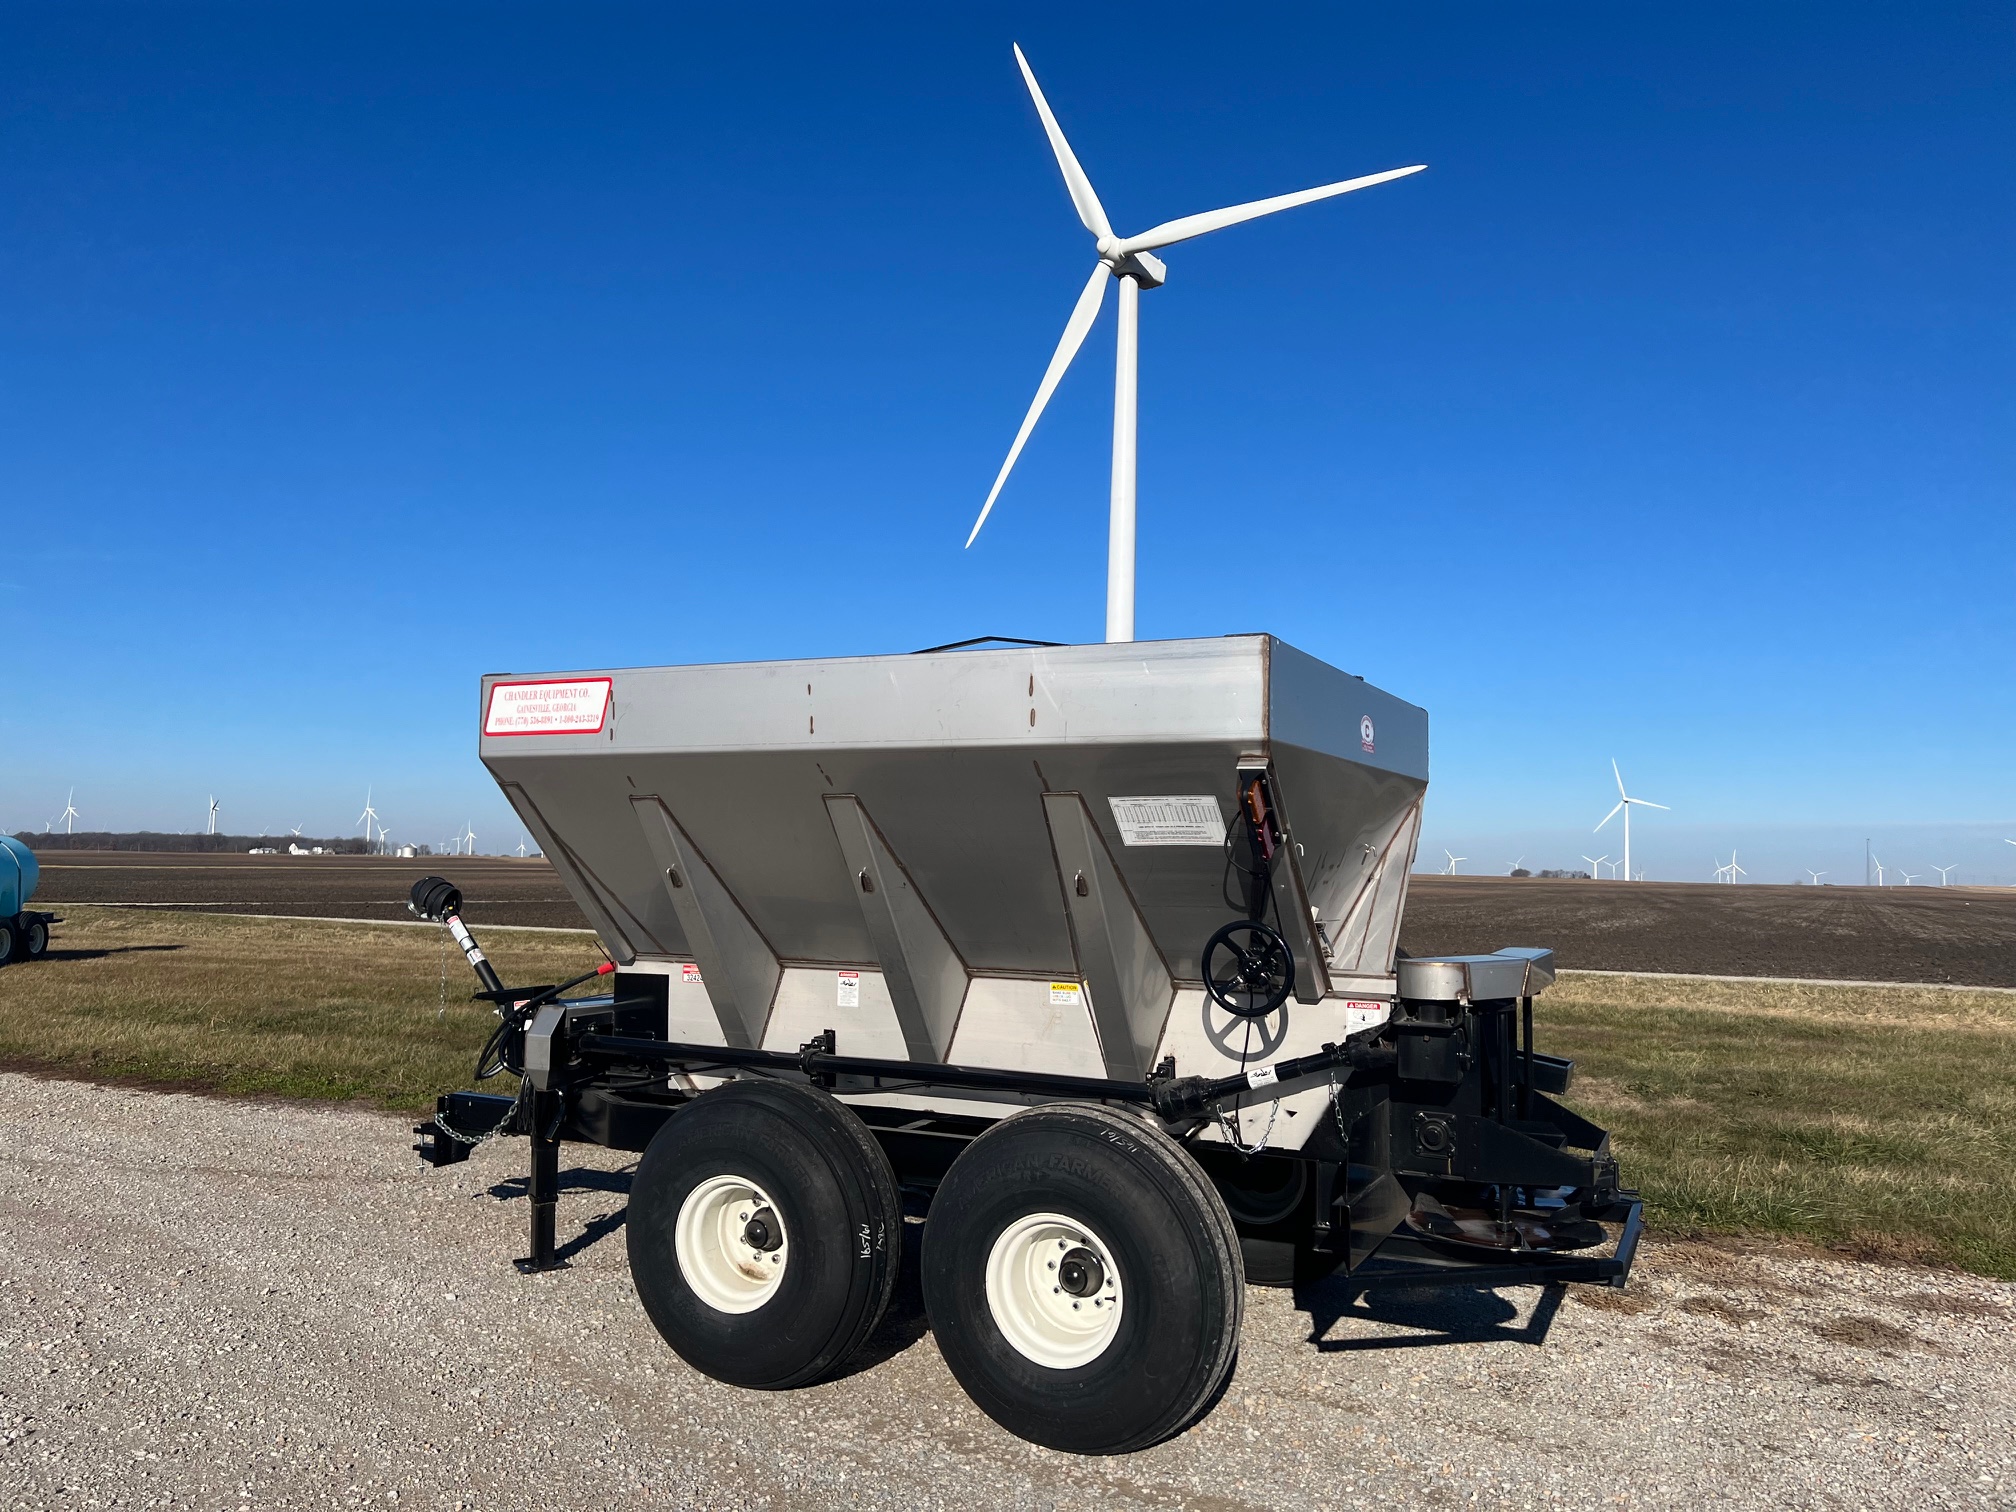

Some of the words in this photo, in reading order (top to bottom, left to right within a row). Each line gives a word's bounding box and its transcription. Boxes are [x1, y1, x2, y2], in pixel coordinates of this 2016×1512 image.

[504, 690, 538, 701] CHANDLER
[539, 688, 578, 702] EQUIPMENT
[579, 688, 590, 698] CO.
[552, 703, 577, 712] GEORGIA
[1048, 1152, 1128, 1199] FARMER
